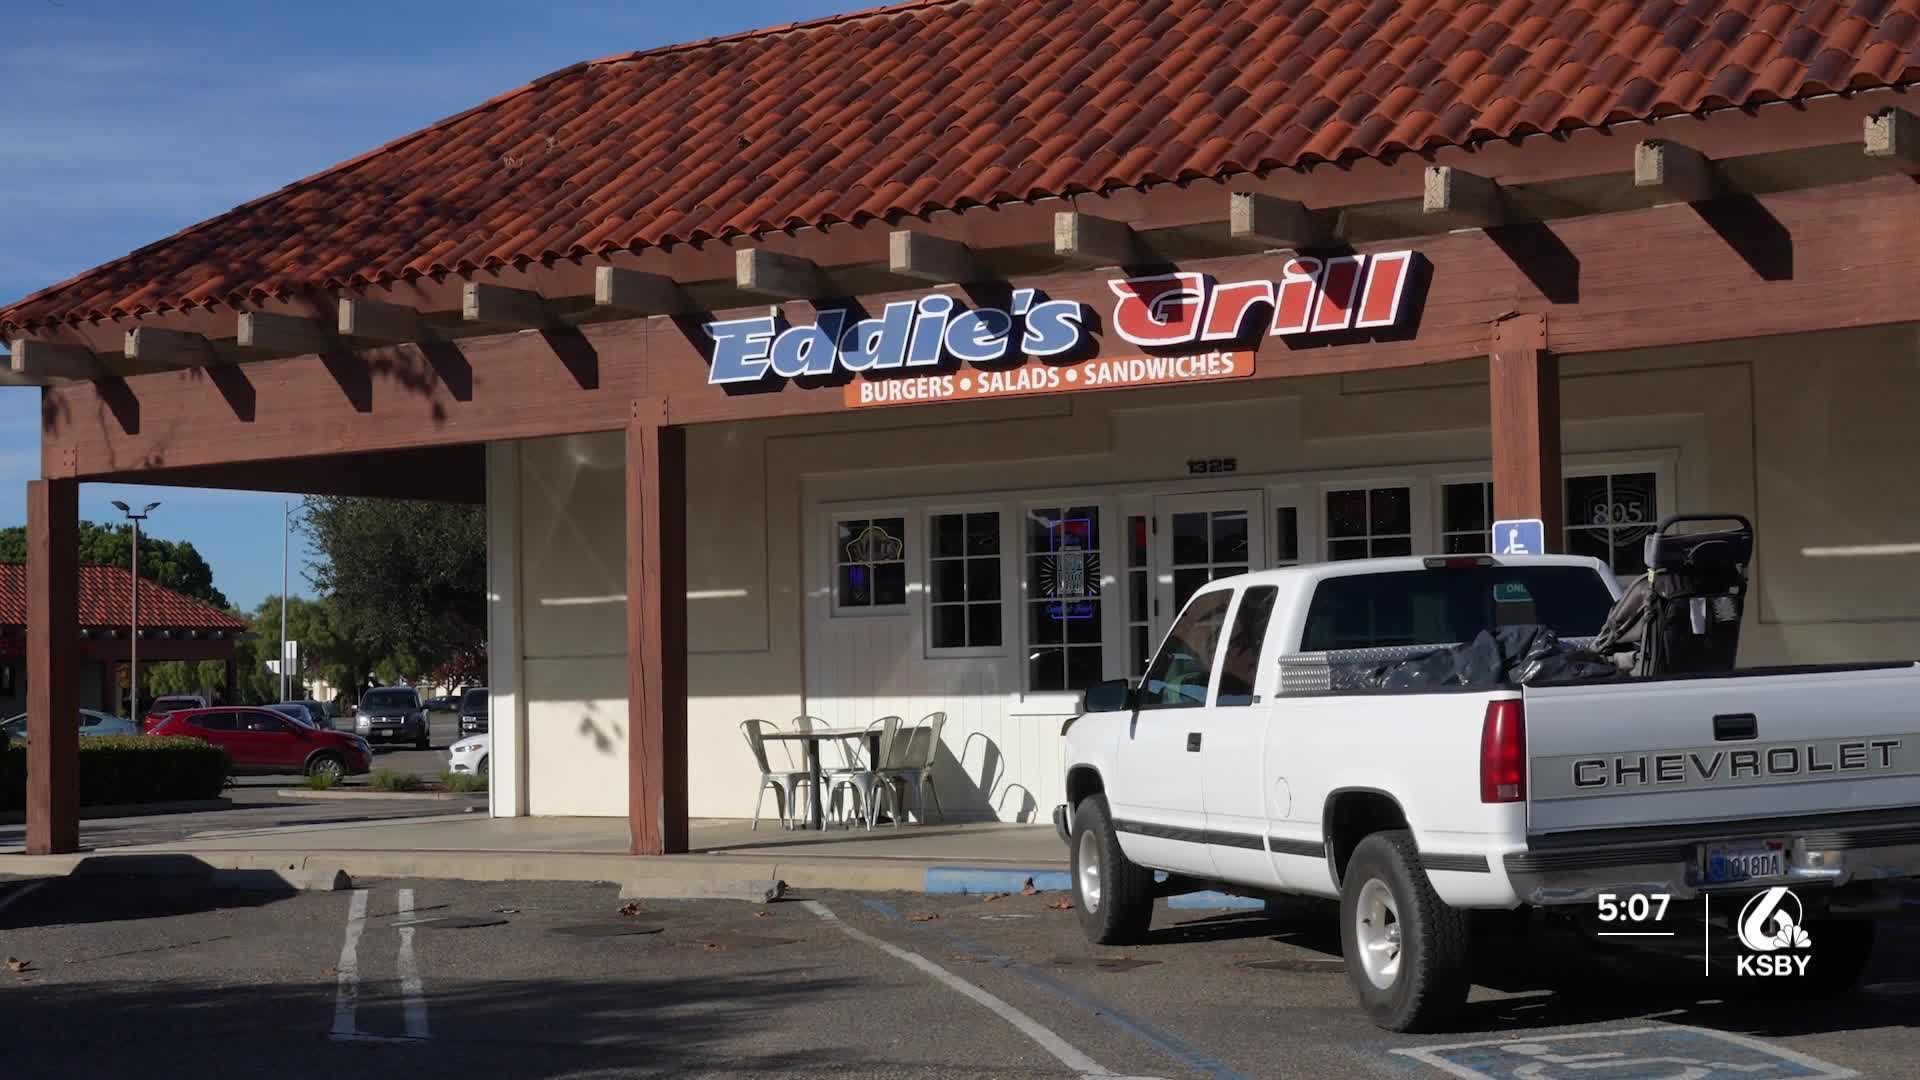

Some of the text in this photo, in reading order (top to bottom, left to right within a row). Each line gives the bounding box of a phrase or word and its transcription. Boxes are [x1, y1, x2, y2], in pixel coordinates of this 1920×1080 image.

[703, 250, 1413, 385] Eddie's Grill
[860, 352, 1235, 403] BURGERS SALADS SANDWICHES
[1186, 458, 1238, 474] 1325
[1593, 502, 1643, 526] 805
[1573, 739, 1902, 789] CHEVROLET
